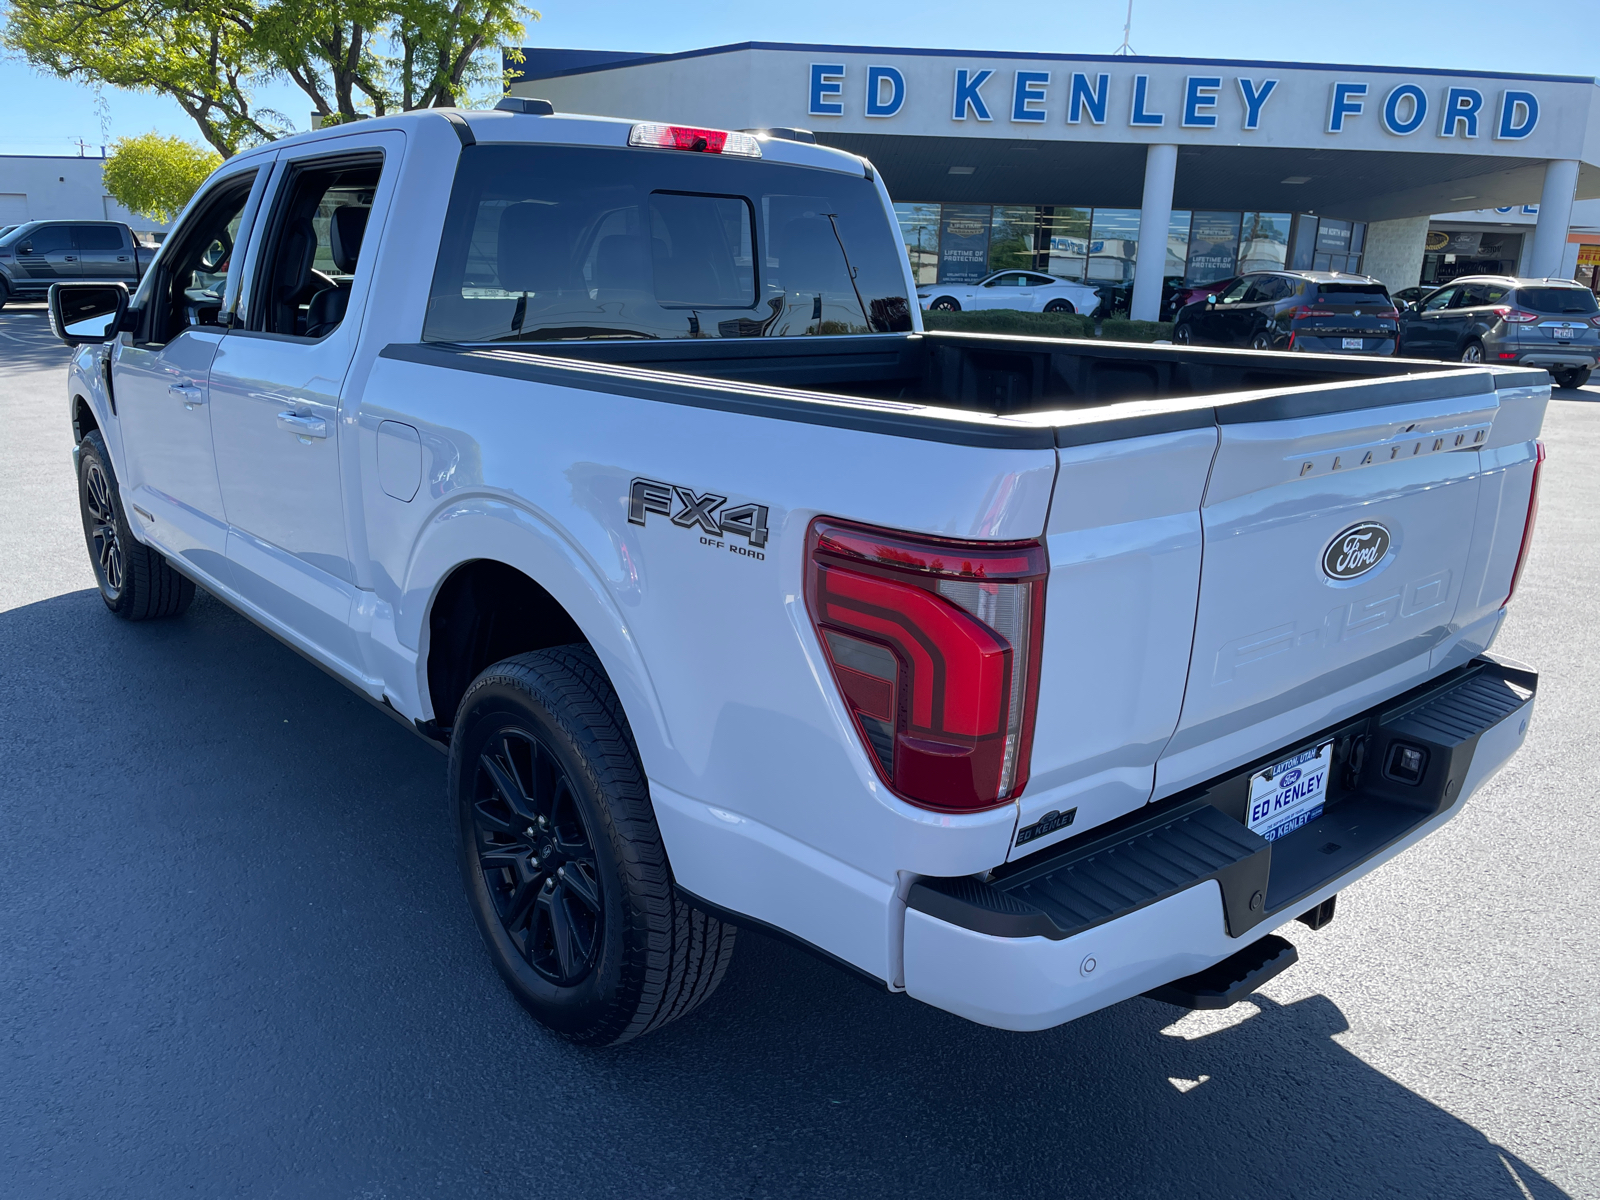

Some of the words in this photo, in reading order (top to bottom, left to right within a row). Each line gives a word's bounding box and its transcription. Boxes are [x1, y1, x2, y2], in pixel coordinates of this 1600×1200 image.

[808, 63, 906, 117] ED
[951, 68, 1280, 130] KENLEY
[1324, 81, 1540, 140] FORD
[1299, 429, 1486, 477] PLATINUM
[627, 476, 769, 550] FX4
[699, 536, 725, 549] OFF
[729, 544, 765, 561] ROAD
[1335, 532, 1382, 572] Ford
[1211, 568, 1453, 688] F-150
[1299, 748, 1317, 763] UTAH
[1252, 799, 1270, 822] ED
[1273, 772, 1324, 812] KENLEY
[1282, 770, 1300, 788] Ford
[1018, 829, 1032, 843] ED
[1034, 812, 1075, 836] KENLEY
[1264, 831, 1276, 842] ED
[1277, 811, 1311, 838] KENLEY
